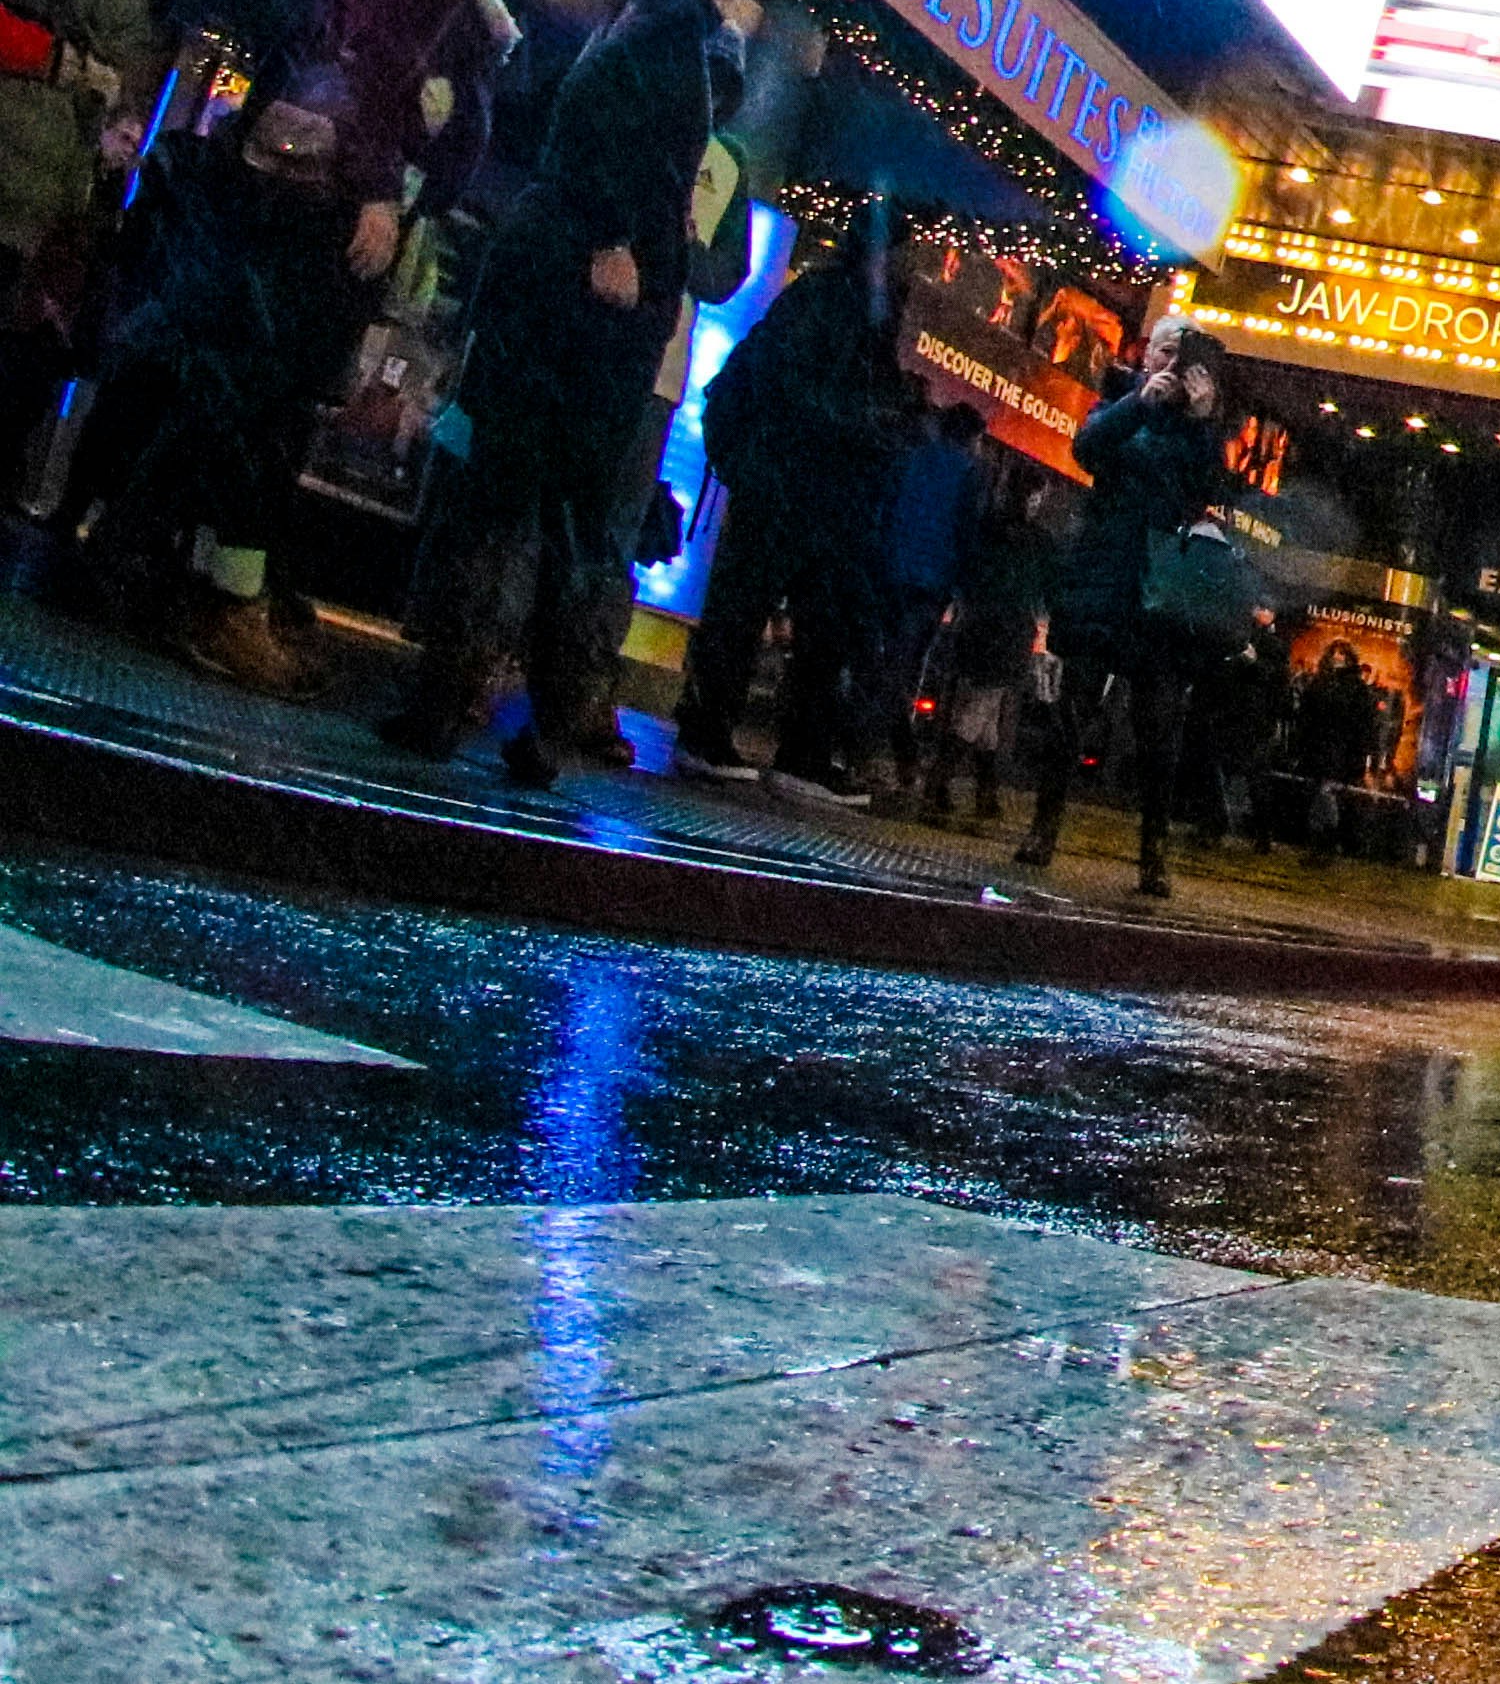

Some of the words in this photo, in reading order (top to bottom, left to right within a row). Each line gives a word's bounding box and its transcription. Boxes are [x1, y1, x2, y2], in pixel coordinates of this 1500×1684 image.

[916, 330, 994, 391] DISCOVER
[994, 374, 1022, 409] THE
[1022, 392, 1077, 441] GOLDEN
[1307, 604, 1414, 636] ILLUSIONISTS
